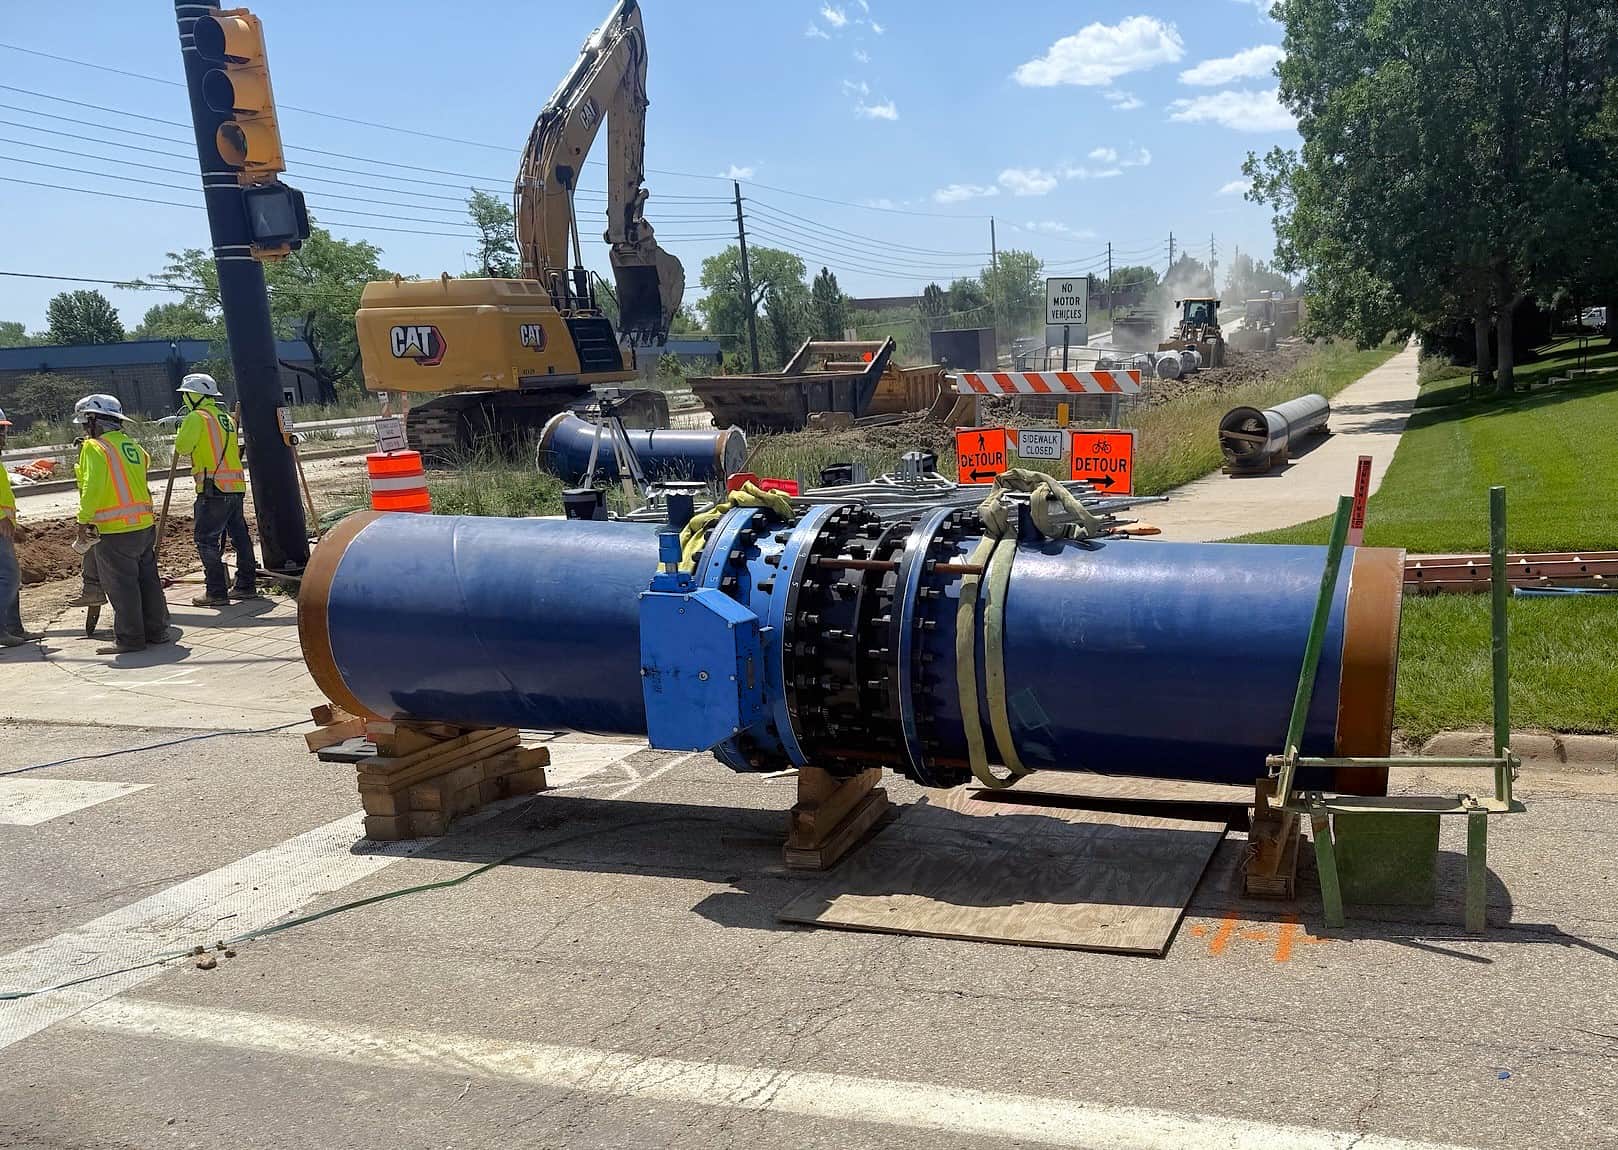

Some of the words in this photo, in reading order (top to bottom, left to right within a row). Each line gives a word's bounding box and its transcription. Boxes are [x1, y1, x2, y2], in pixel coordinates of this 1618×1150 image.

[1061, 283, 1073, 293] NO
[1053, 296, 1080, 306] MOTOR
[1051, 309, 1082, 319] VEHICLES
[520, 325, 541, 347] CAT
[391, 326, 432, 358] CAT
[1022, 434, 1059, 445] SIDEWALK
[1025, 446, 1054, 456] CLOSED
[960, 452, 1003, 468] DETOUR
[1075, 458, 1127, 473] DETOUR
